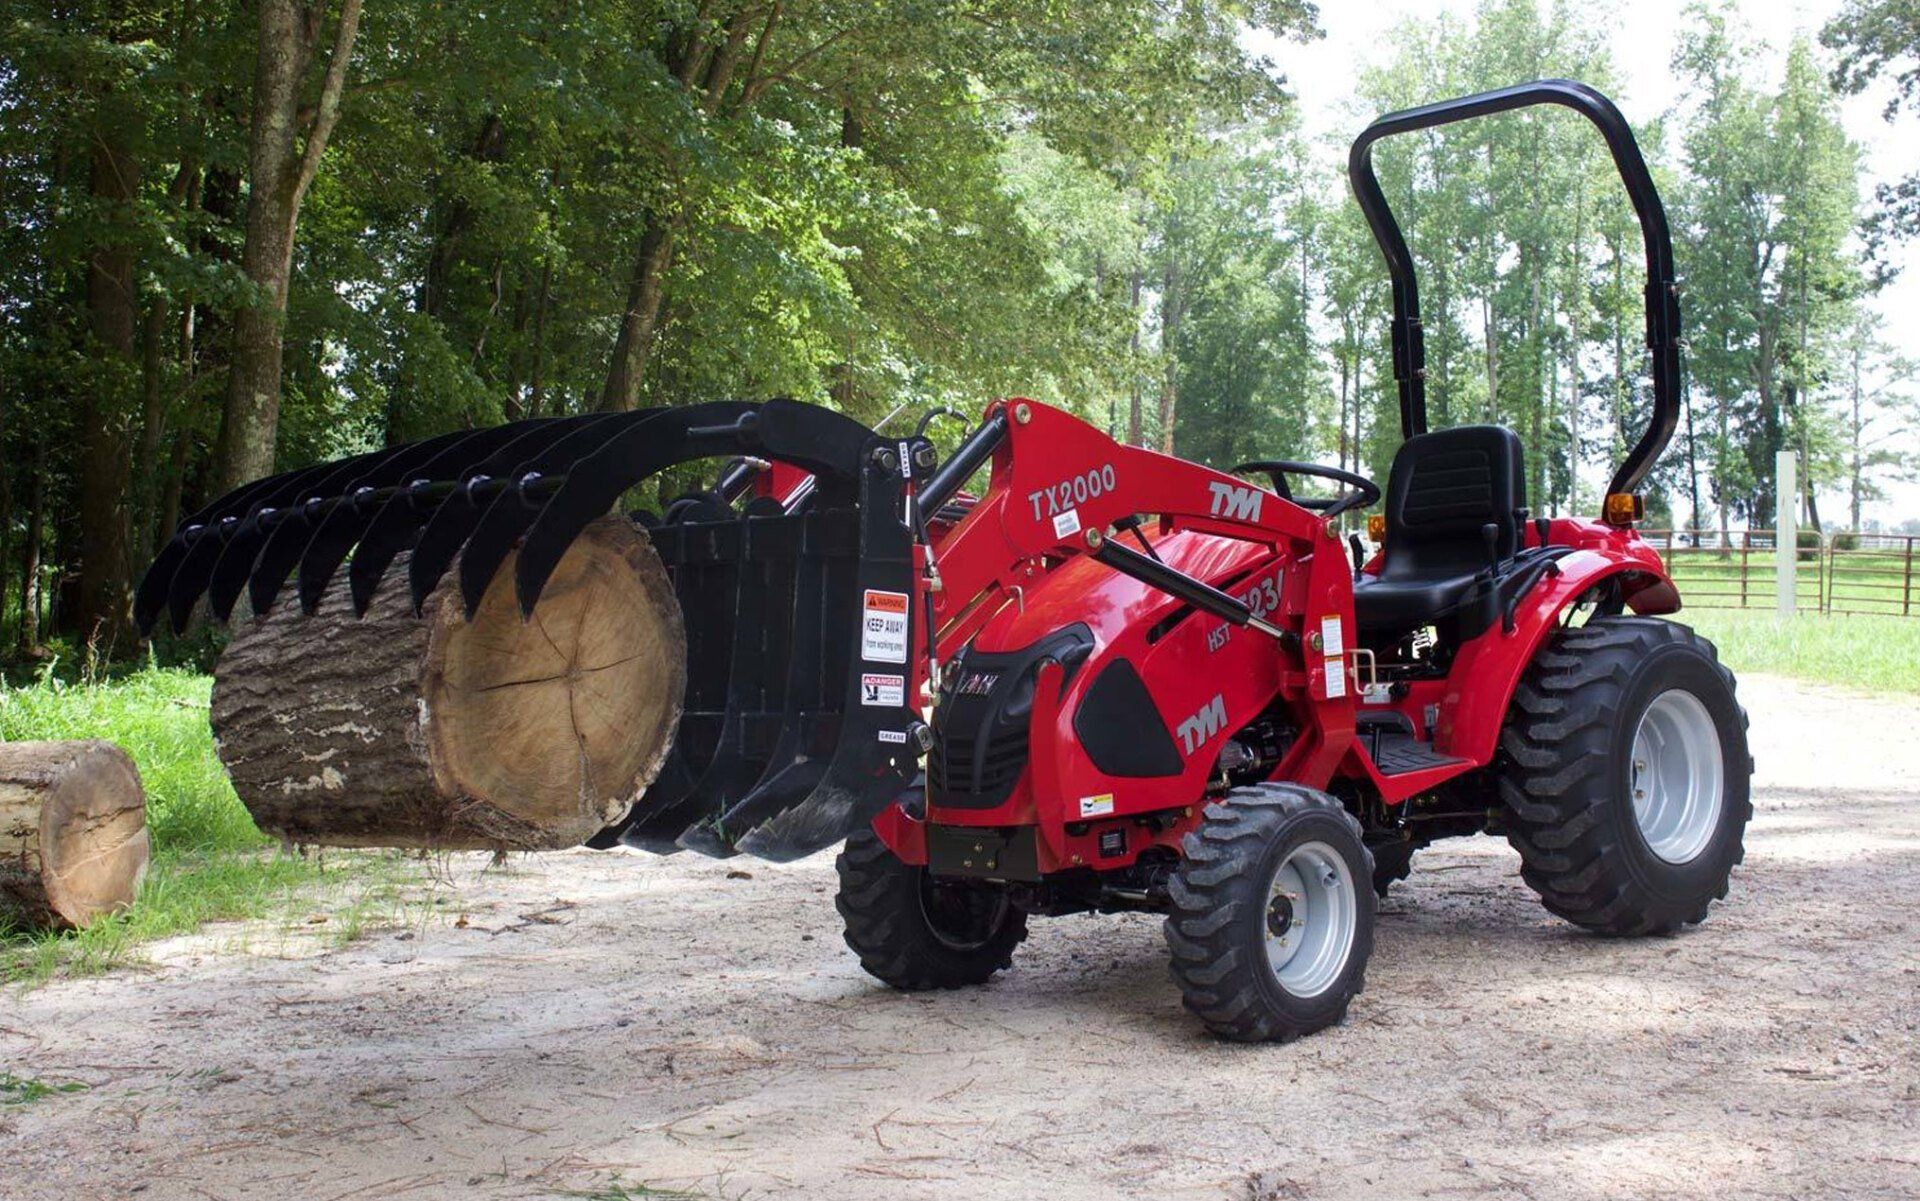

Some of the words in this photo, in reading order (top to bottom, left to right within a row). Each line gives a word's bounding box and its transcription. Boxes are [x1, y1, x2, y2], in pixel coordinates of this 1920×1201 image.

[1028, 463, 1116, 521] TX2000
[1208, 481, 1264, 523] TYM
[866, 617, 884, 632] KEEP
[885, 620, 904, 634] AWAY
[1207, 622, 1231, 652] HST
[880, 732, 905, 741] GREASE
[1176, 694, 1228, 755] TYM
